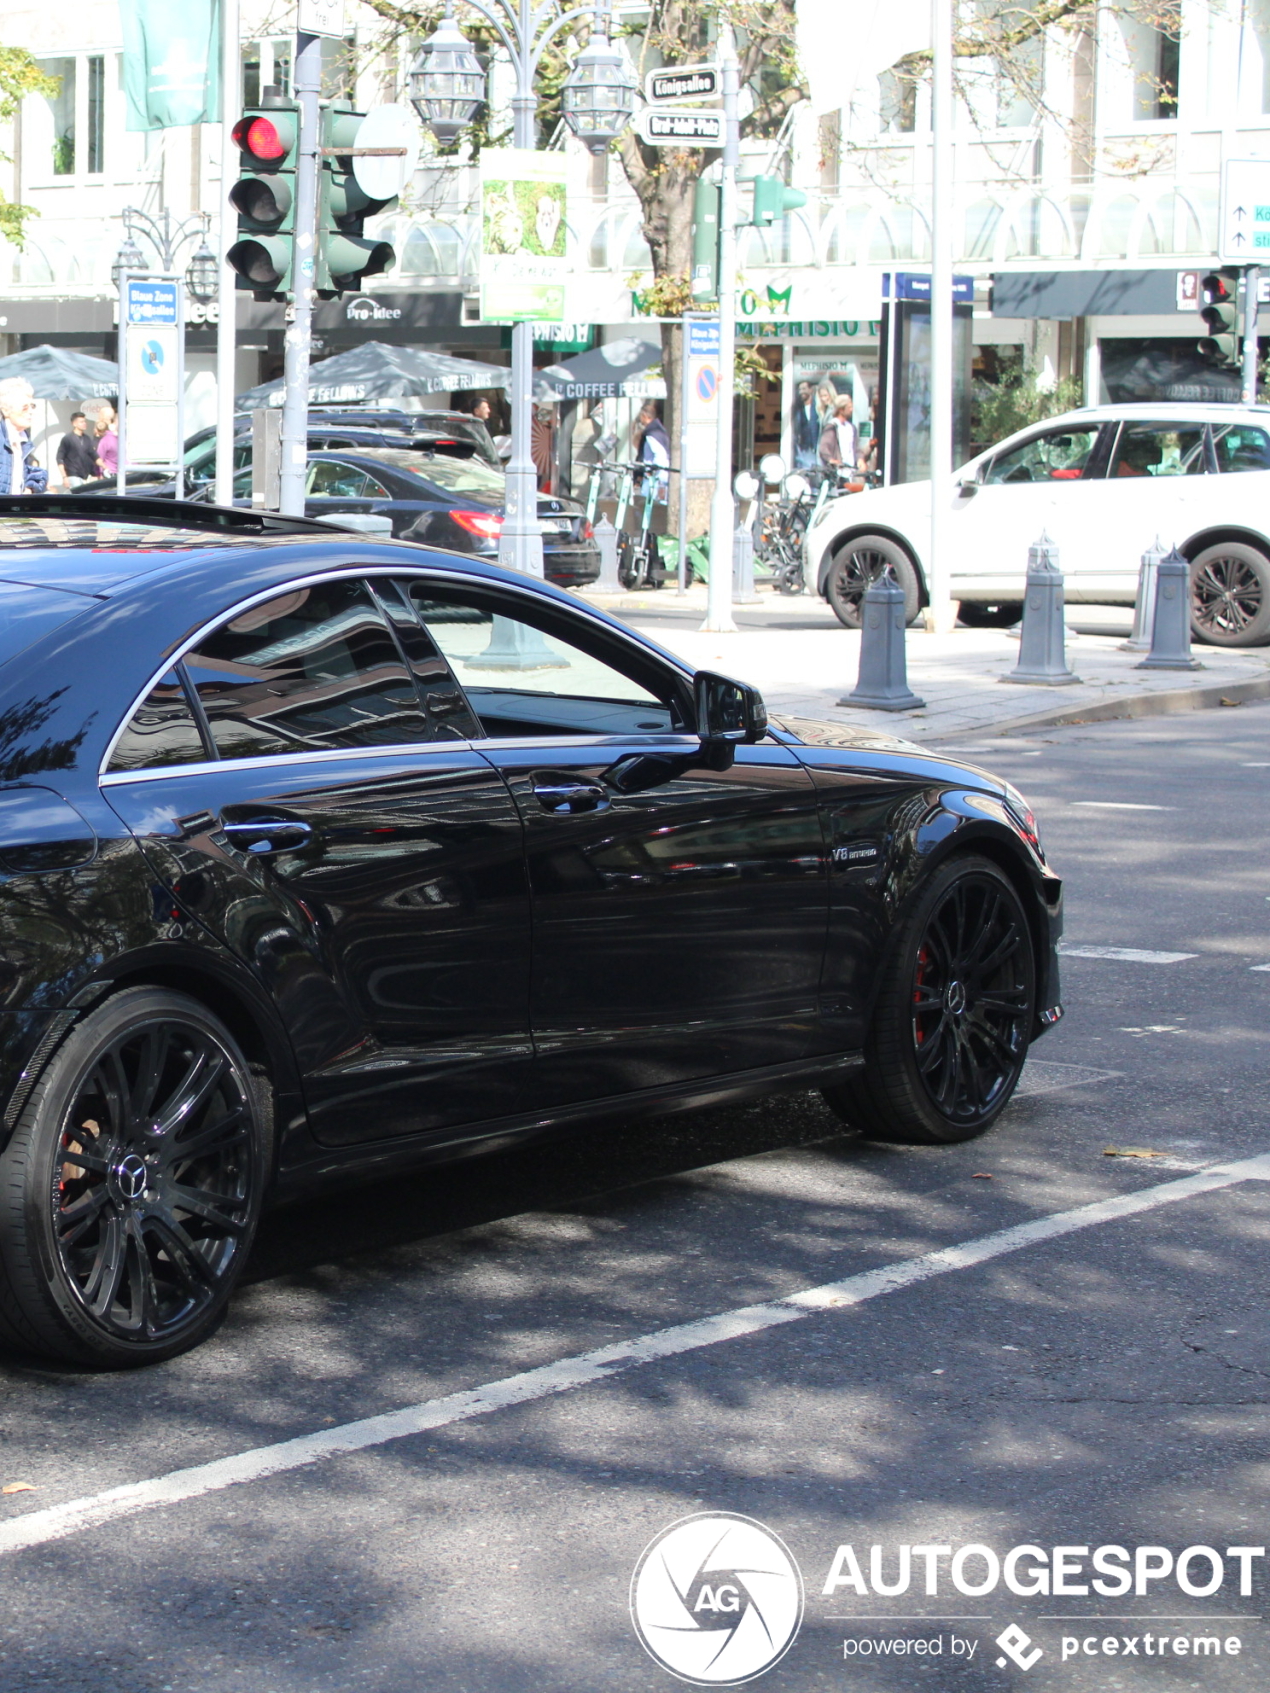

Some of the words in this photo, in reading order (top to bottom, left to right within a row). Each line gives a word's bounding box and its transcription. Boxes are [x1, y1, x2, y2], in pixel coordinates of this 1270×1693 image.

[654, 74, 711, 96] Königsallee
[131, 290, 153, 302] Blaue
[154, 290, 174, 302] Zone
[532, 322, 575, 342] PHISTO
[735, 320, 860, 337] MEPHISTO
[566, 383, 615, 398] COFFEE
[619, 382, 668, 398] FELLOW
[832, 847, 848, 861] V8
